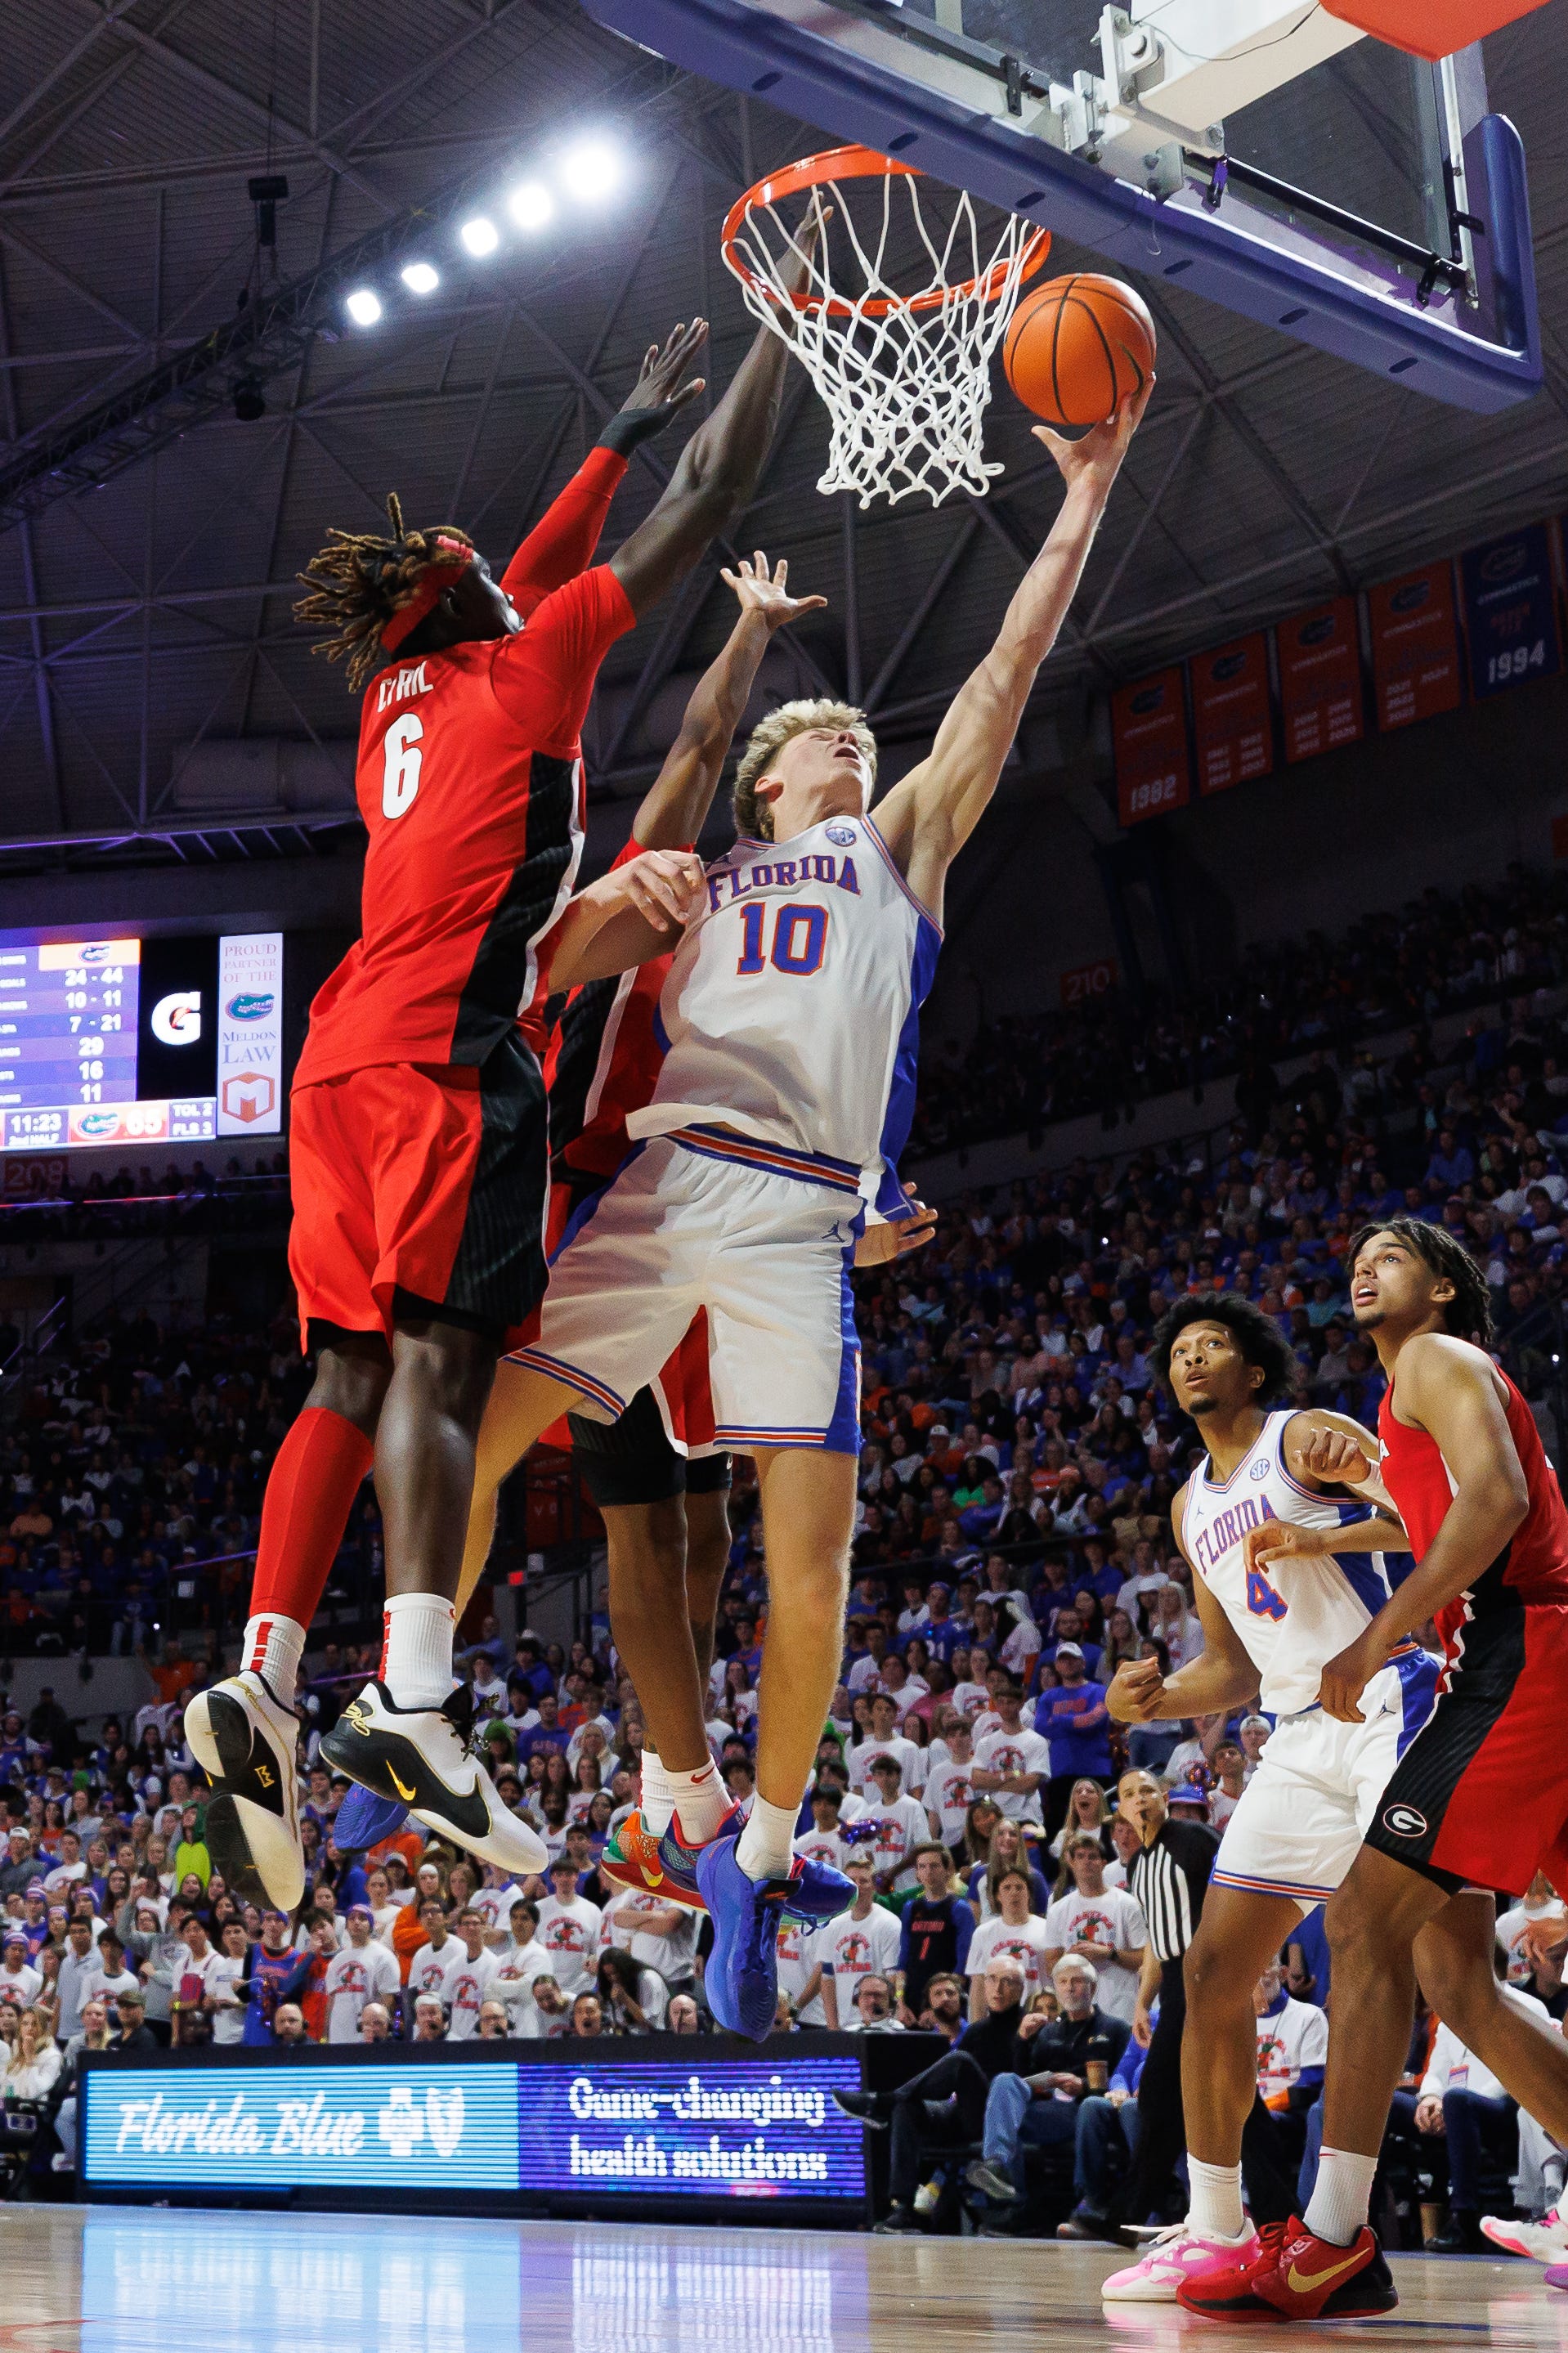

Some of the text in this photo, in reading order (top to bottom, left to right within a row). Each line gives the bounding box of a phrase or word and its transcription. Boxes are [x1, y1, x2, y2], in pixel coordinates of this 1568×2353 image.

[1488, 639, 1545, 683] 1994
[382, 712, 423, 820] 6
[706, 854, 862, 914] FLORIDA
[737, 902, 829, 976] 10
[224, 943, 277, 957] PROUD
[224, 958, 277, 969] PARTNER
[65, 969, 87, 987] 24
[101, 967, 123, 984] 44
[223, 970, 277, 983] OF THE
[65, 992, 87, 1008] 10
[102, 990, 122, 1006] 11
[69, 1016, 82, 1033] 7
[101, 1014, 122, 1031] 21
[151, 991, 201, 1046] G
[78, 1037, 105, 1056] 29
[222, 1030, 277, 1043] MELDON
[222, 1045, 277, 1064] LAW
[79, 1061, 104, 1080] 16
[80, 1083, 101, 1103] 11
[202, 1103, 213, 1117] 2
[11, 1113, 62, 1132] 11:23
[126, 1109, 163, 1136] 65
[202, 1121, 213, 1135] 3
[1195, 1494, 1279, 1576] FLORIDA
[1247, 1571, 1288, 1622] 4
[1389, 1808, 1426, 1832] G
[919, 1936, 930, 1961] 1
[568, 2076, 826, 2127] Game-changing
[115, 2089, 365, 2156] Florida Blue
[570, 2134, 828, 2180] health solutions
